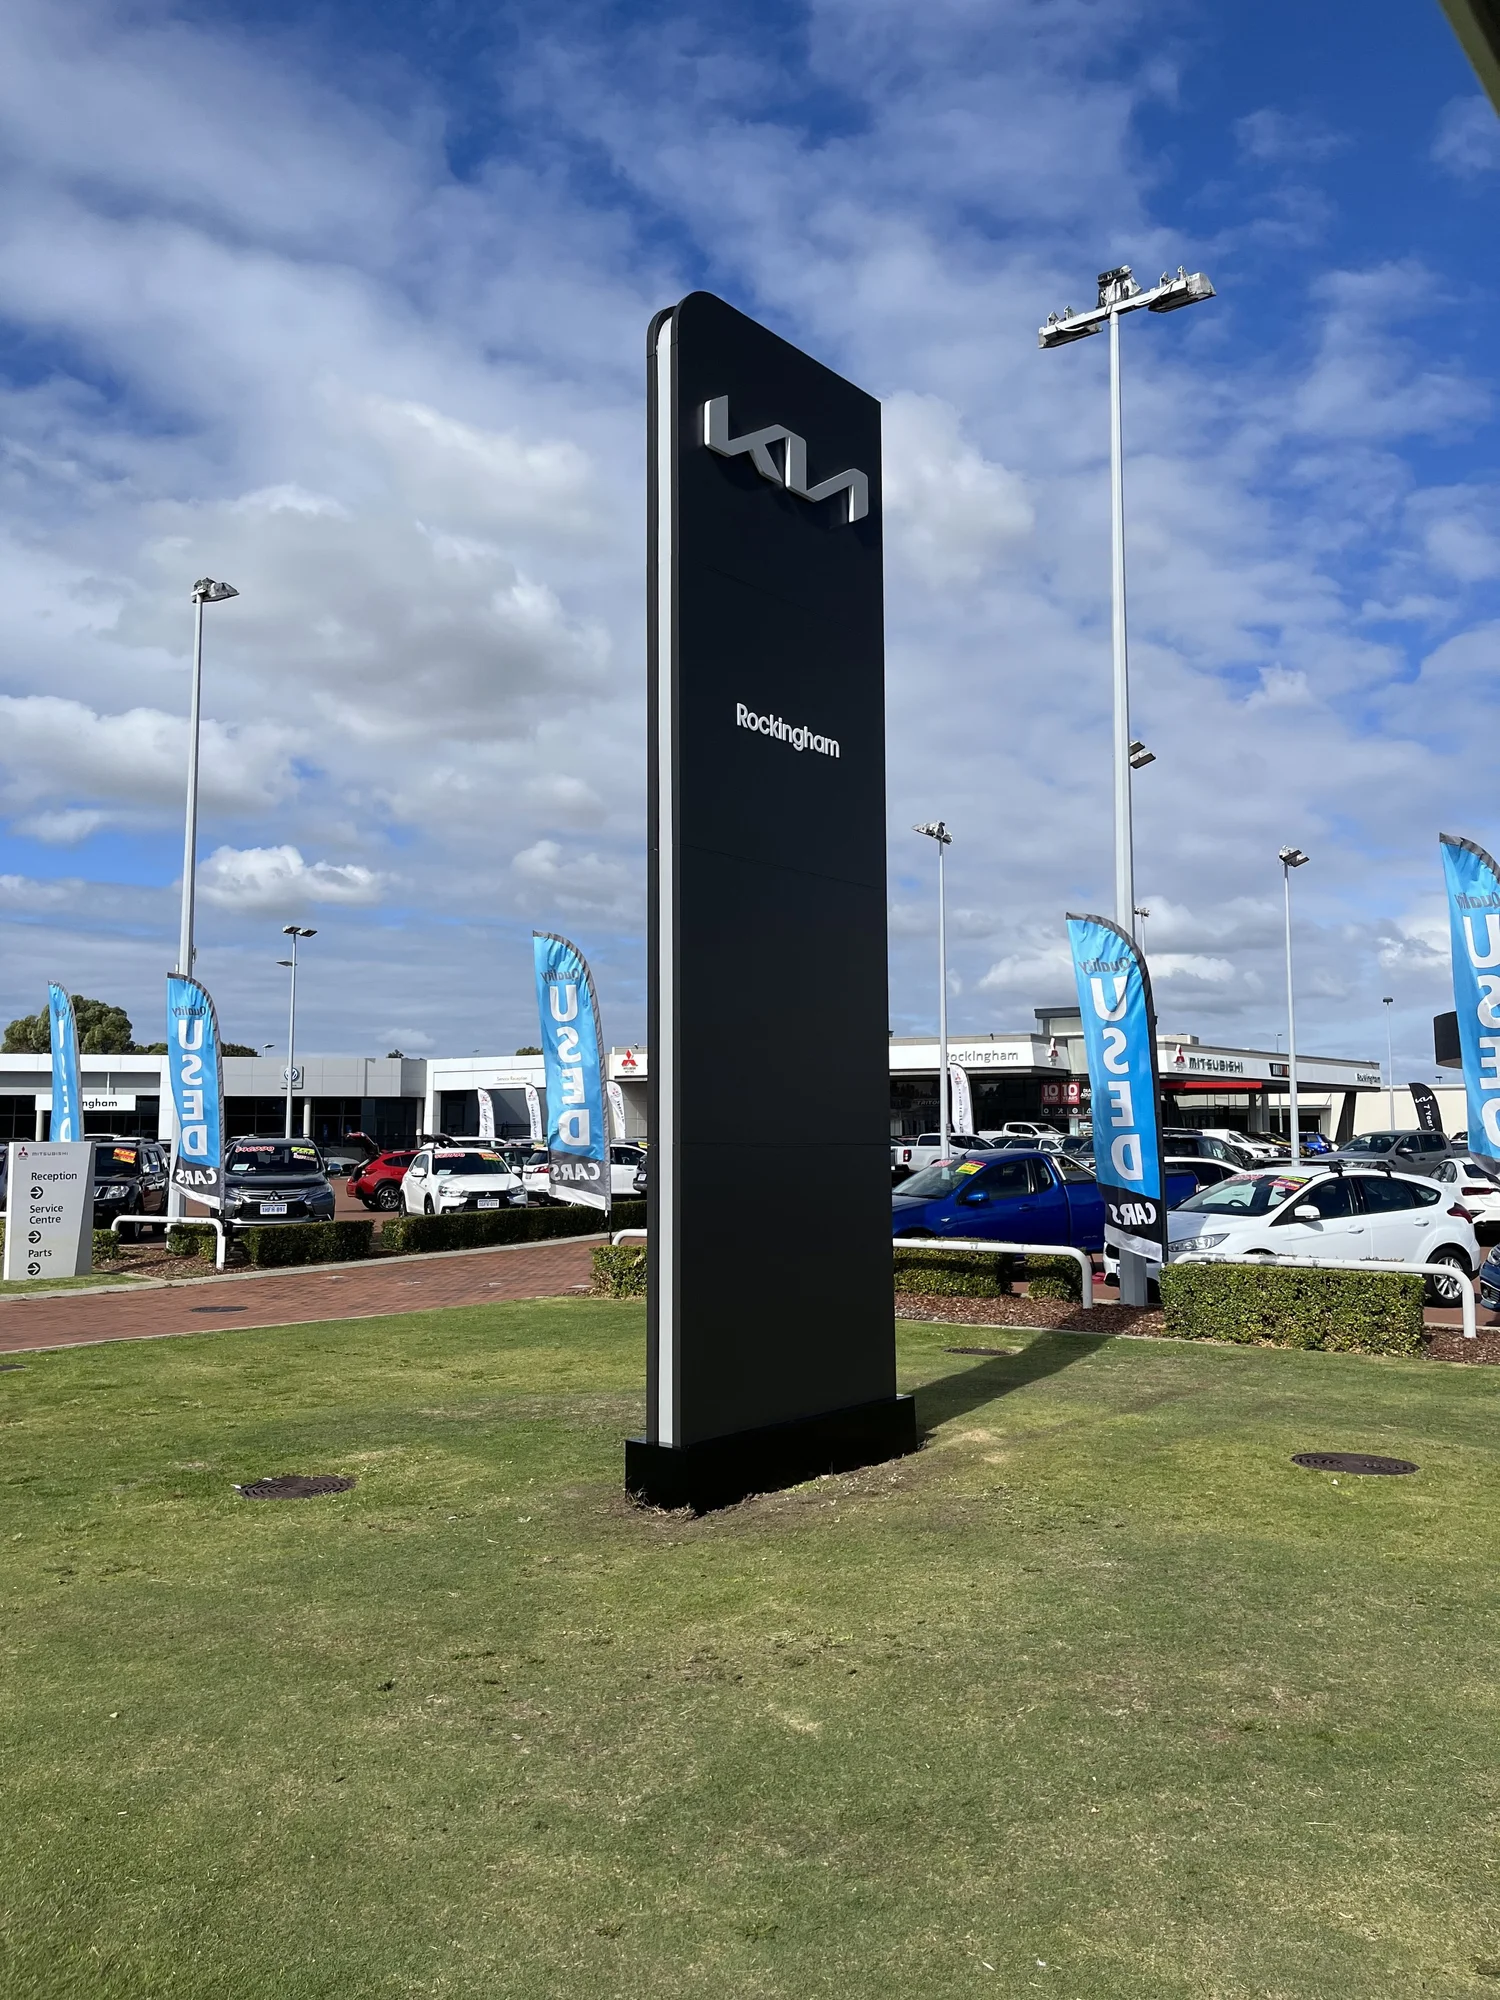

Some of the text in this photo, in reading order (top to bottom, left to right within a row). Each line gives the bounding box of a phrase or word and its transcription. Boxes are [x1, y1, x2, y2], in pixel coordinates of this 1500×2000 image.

[736, 702, 840, 759] Rockingham
[1188, 1057, 1244, 1074] MITSUBISHI
[1062, 1084, 1078, 1096] 10
[82, 1097, 118, 1109] ngham
[1425, 1110, 1434, 1128] Year
[30, 1171, 78, 1182] Reception
[29, 1203, 64, 1214] Service
[29, 1215, 62, 1225] Centre
[28, 1248, 53, 1258] Parts
